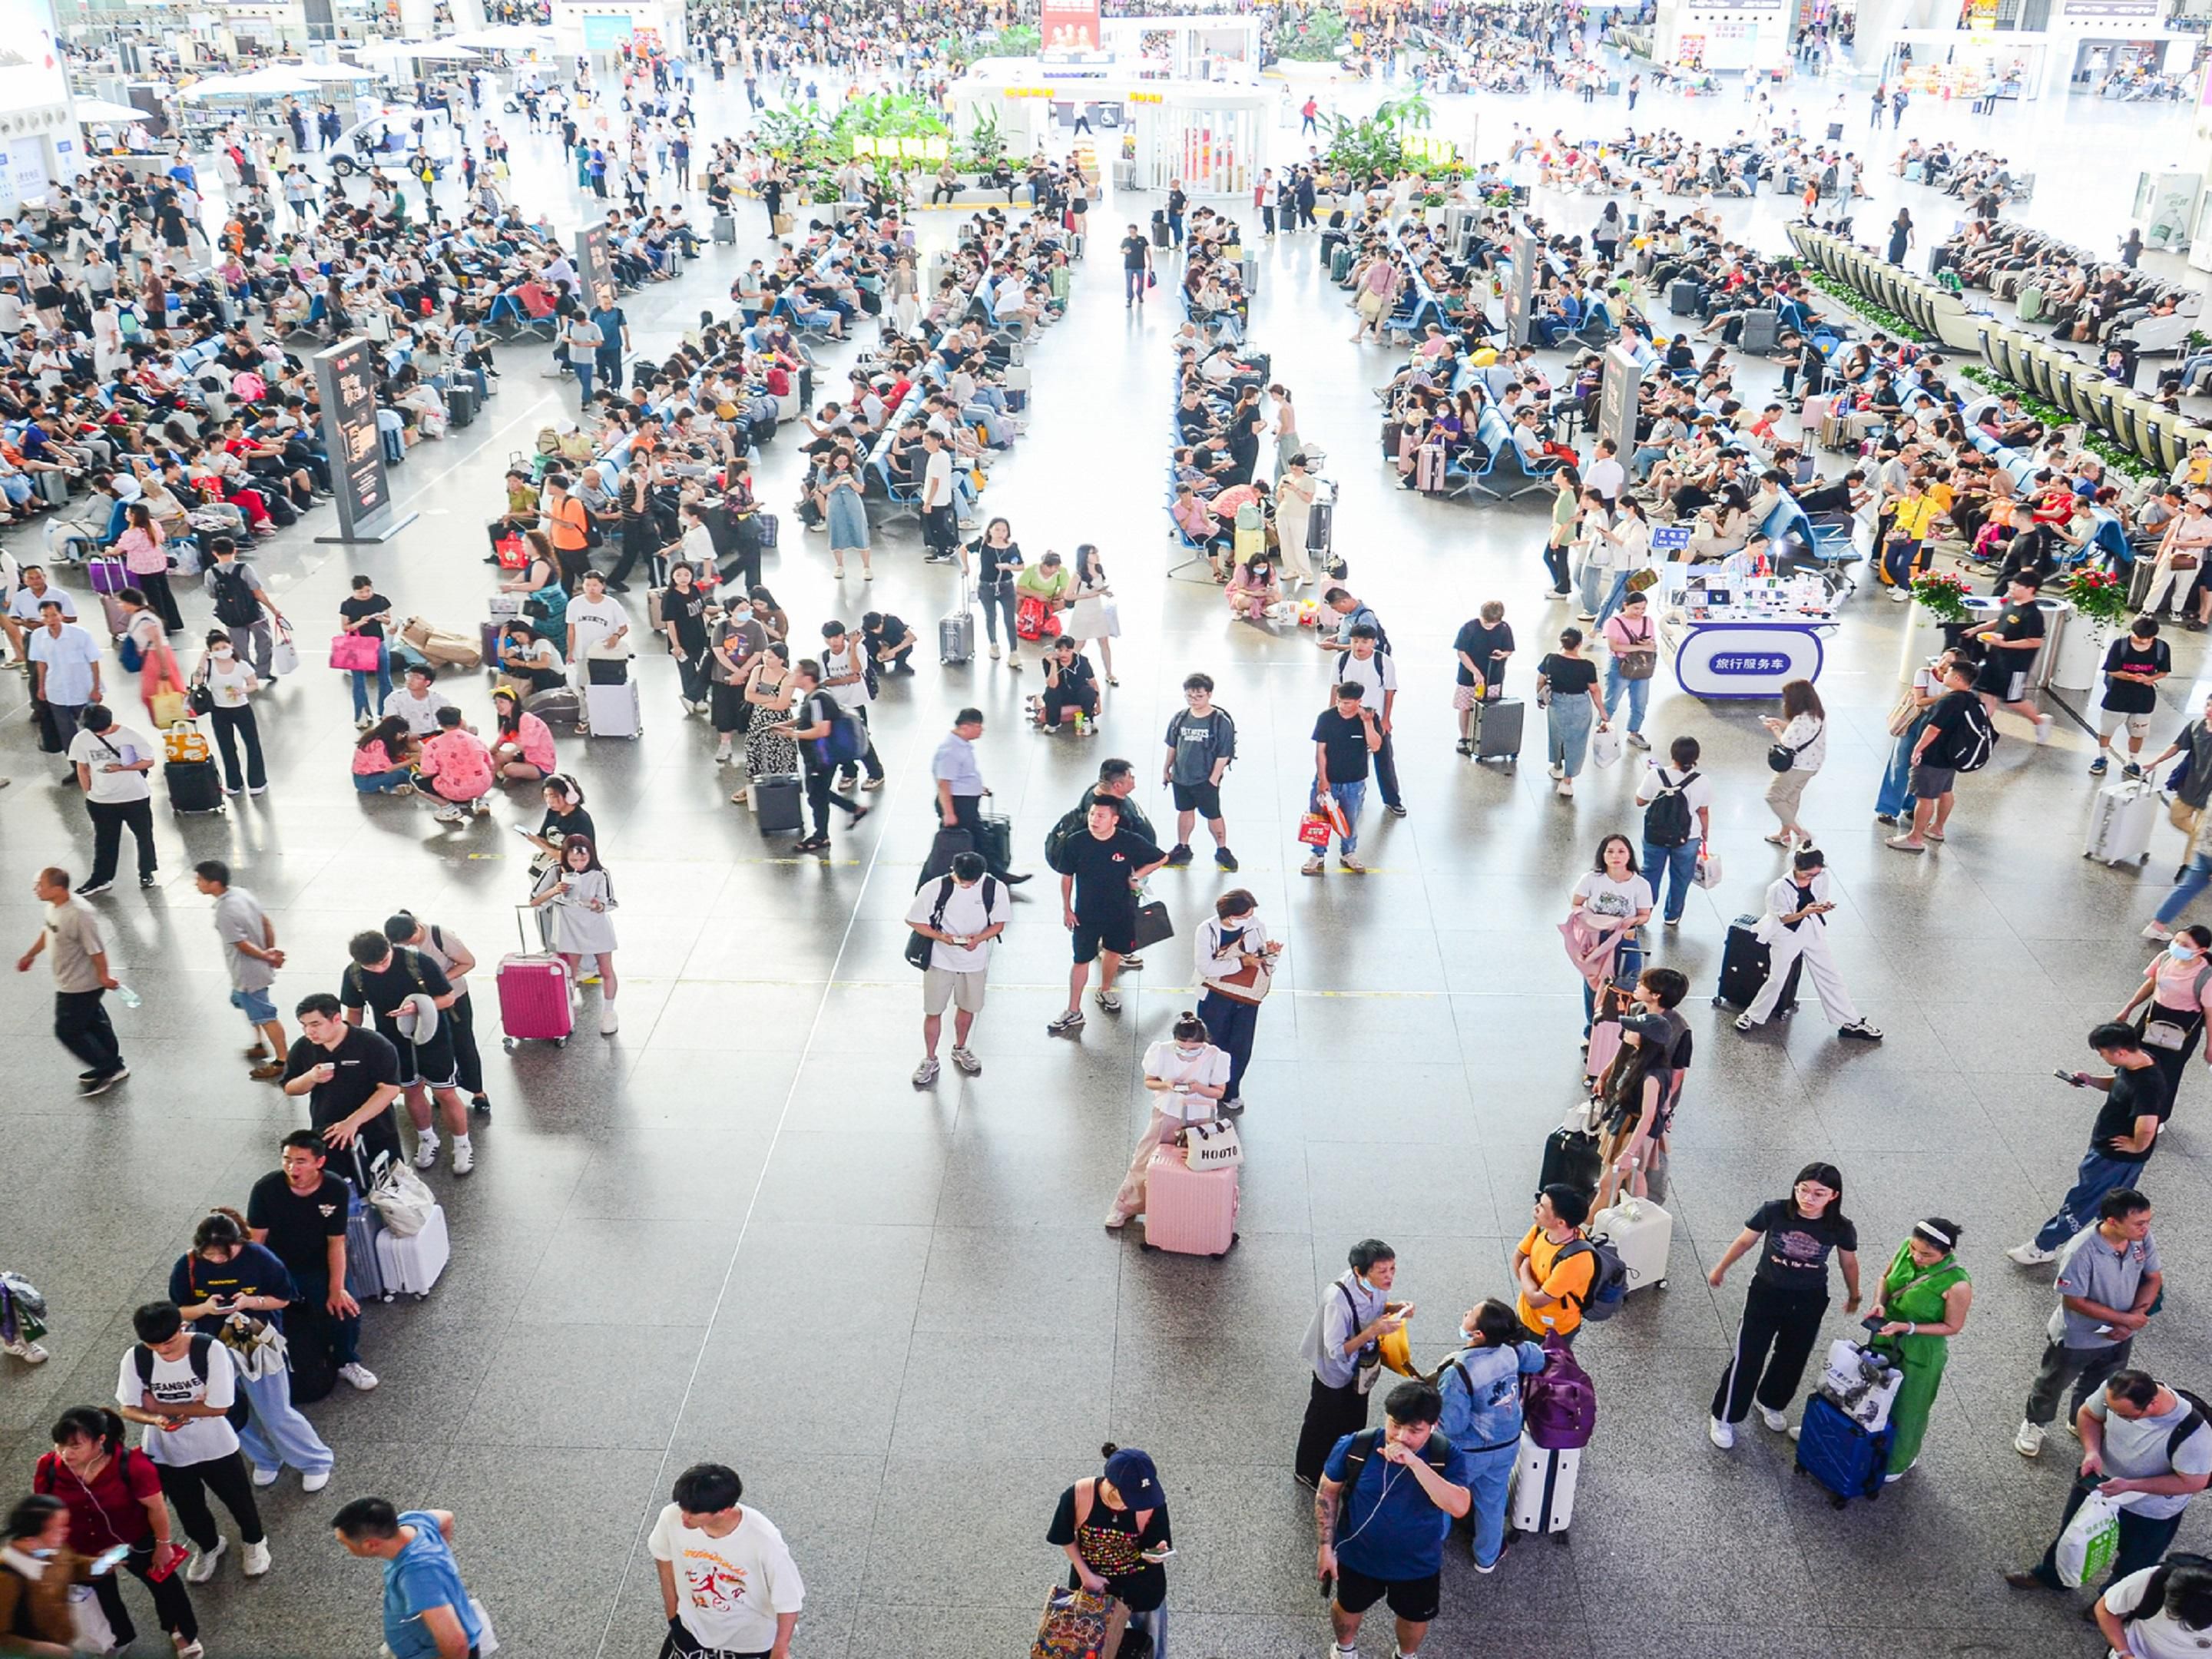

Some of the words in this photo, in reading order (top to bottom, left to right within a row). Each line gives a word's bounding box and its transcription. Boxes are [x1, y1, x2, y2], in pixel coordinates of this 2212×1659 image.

[1715, 658, 1784, 670] 旅行服务车
